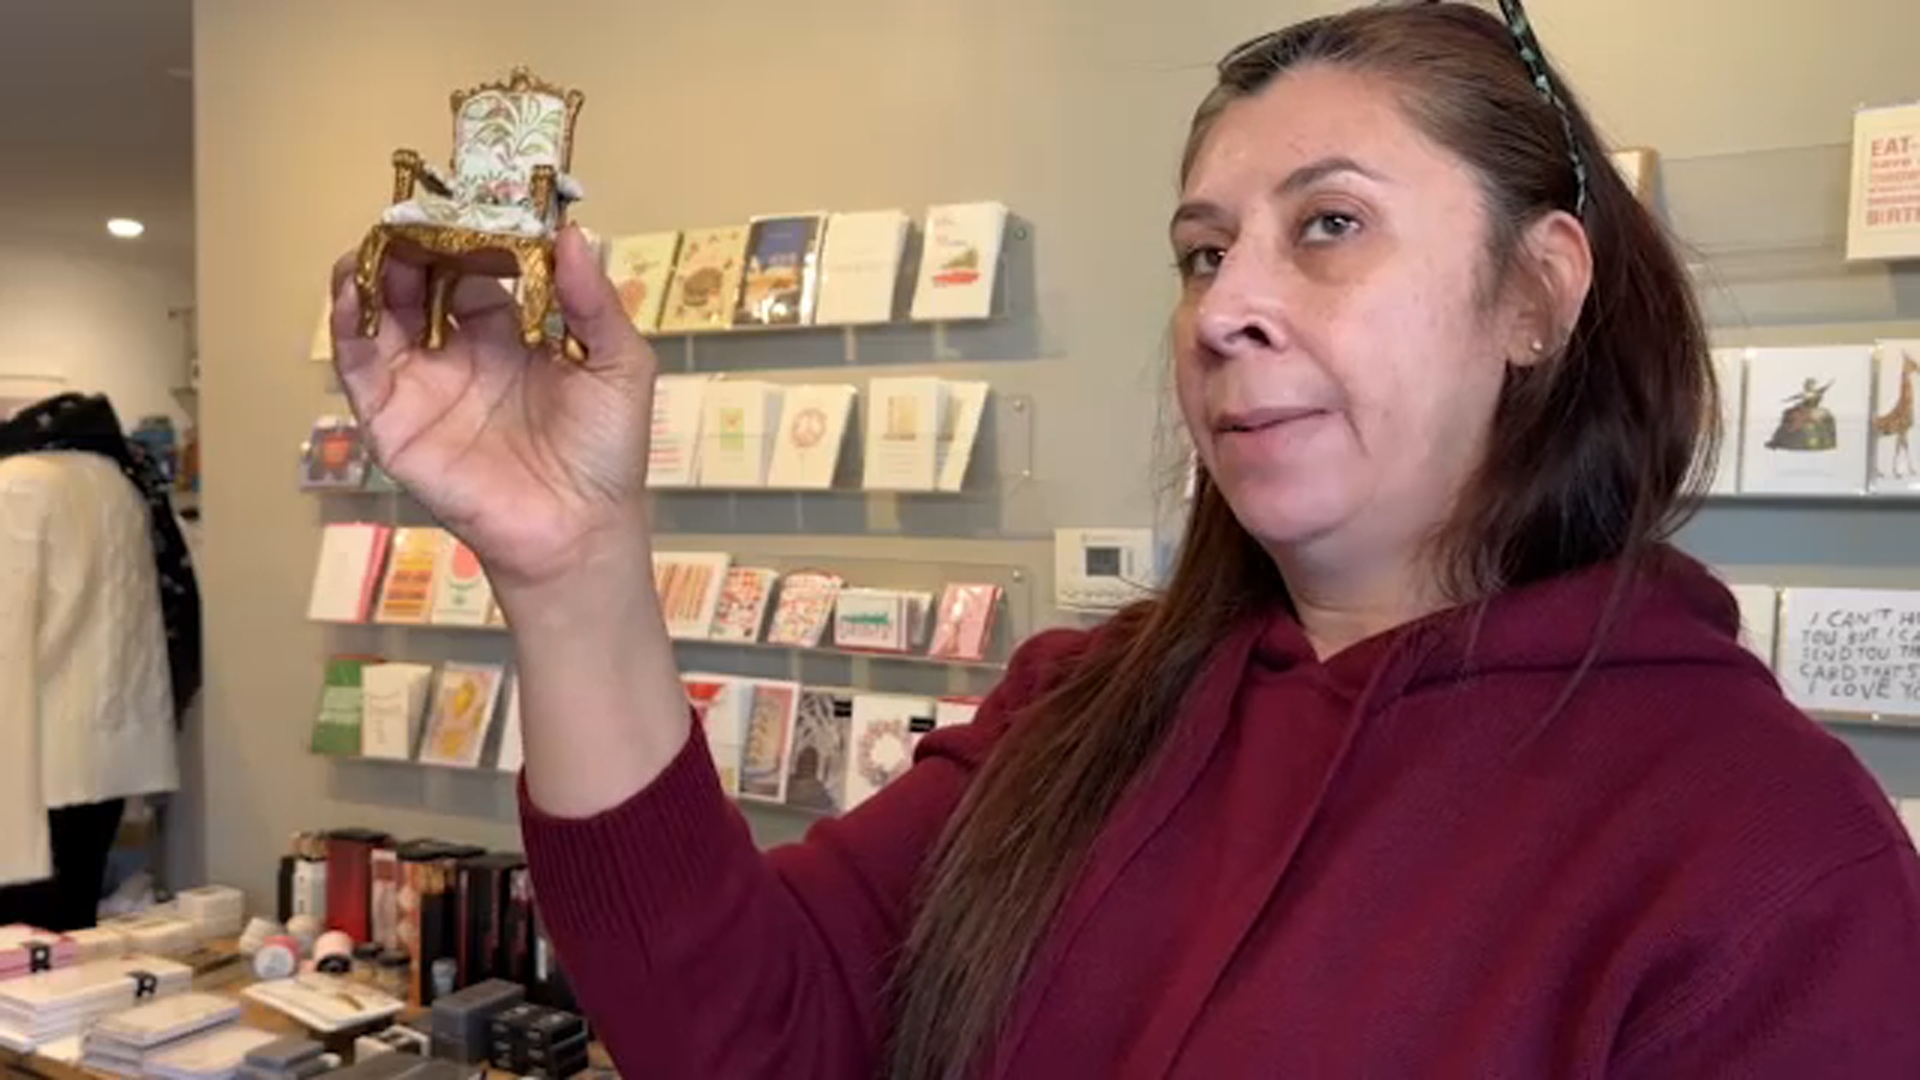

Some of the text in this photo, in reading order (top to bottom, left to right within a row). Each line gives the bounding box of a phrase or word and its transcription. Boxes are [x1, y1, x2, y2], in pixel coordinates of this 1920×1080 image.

[1810, 611, 1820, 626] I
[1827, 609, 1893, 628] CAN'T
[1830, 679, 1891, 700] LOVE
